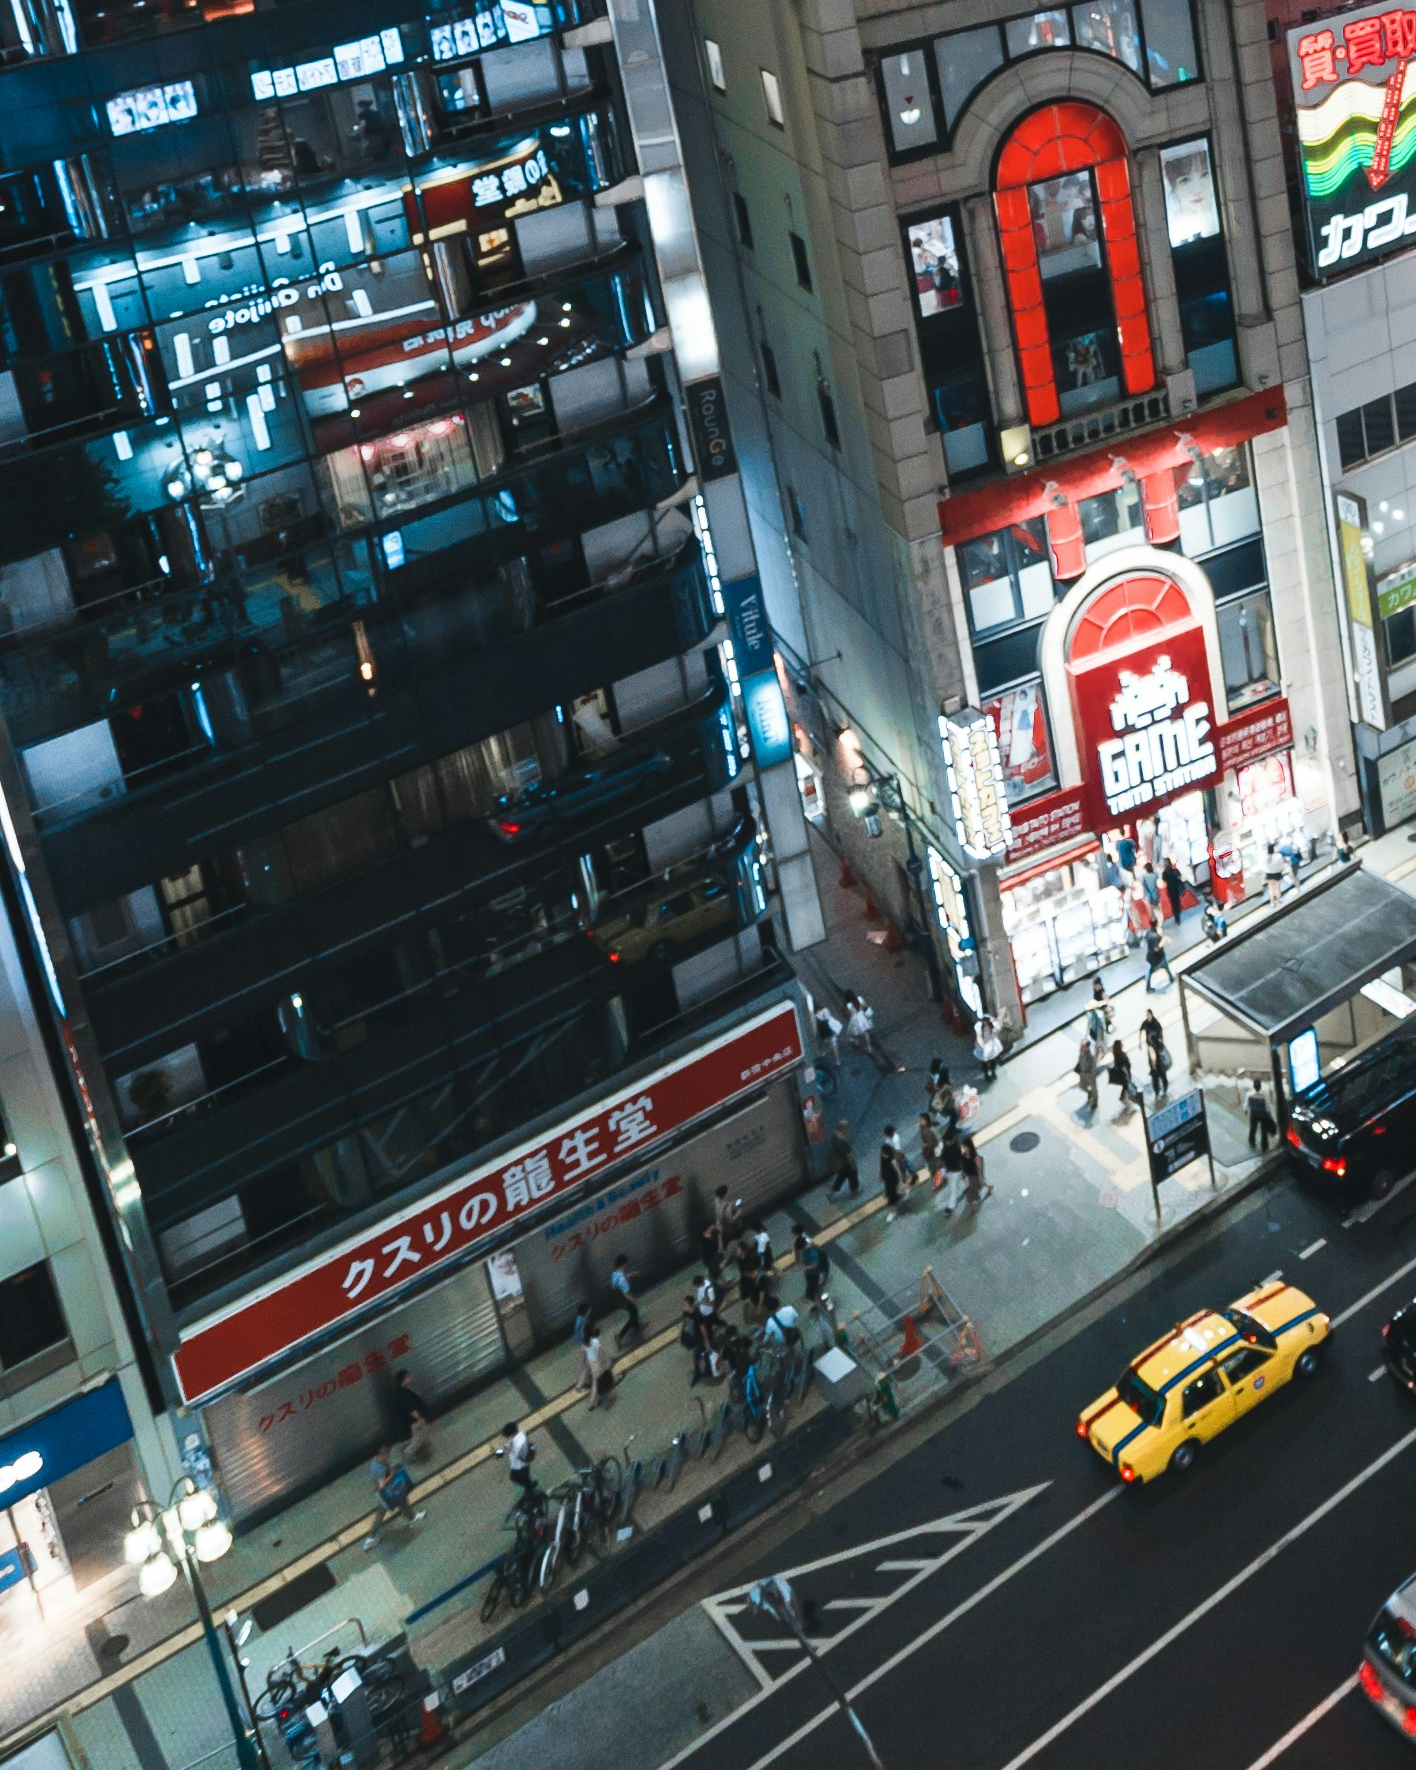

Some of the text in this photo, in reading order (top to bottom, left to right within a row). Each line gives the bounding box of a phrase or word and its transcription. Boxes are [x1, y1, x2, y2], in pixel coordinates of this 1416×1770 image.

[1098, 701, 1214, 796] GAME
[1106, 753, 1218, 816] TAITO STATION
[341, 1096, 660, 1300] クスリの龍生堂
